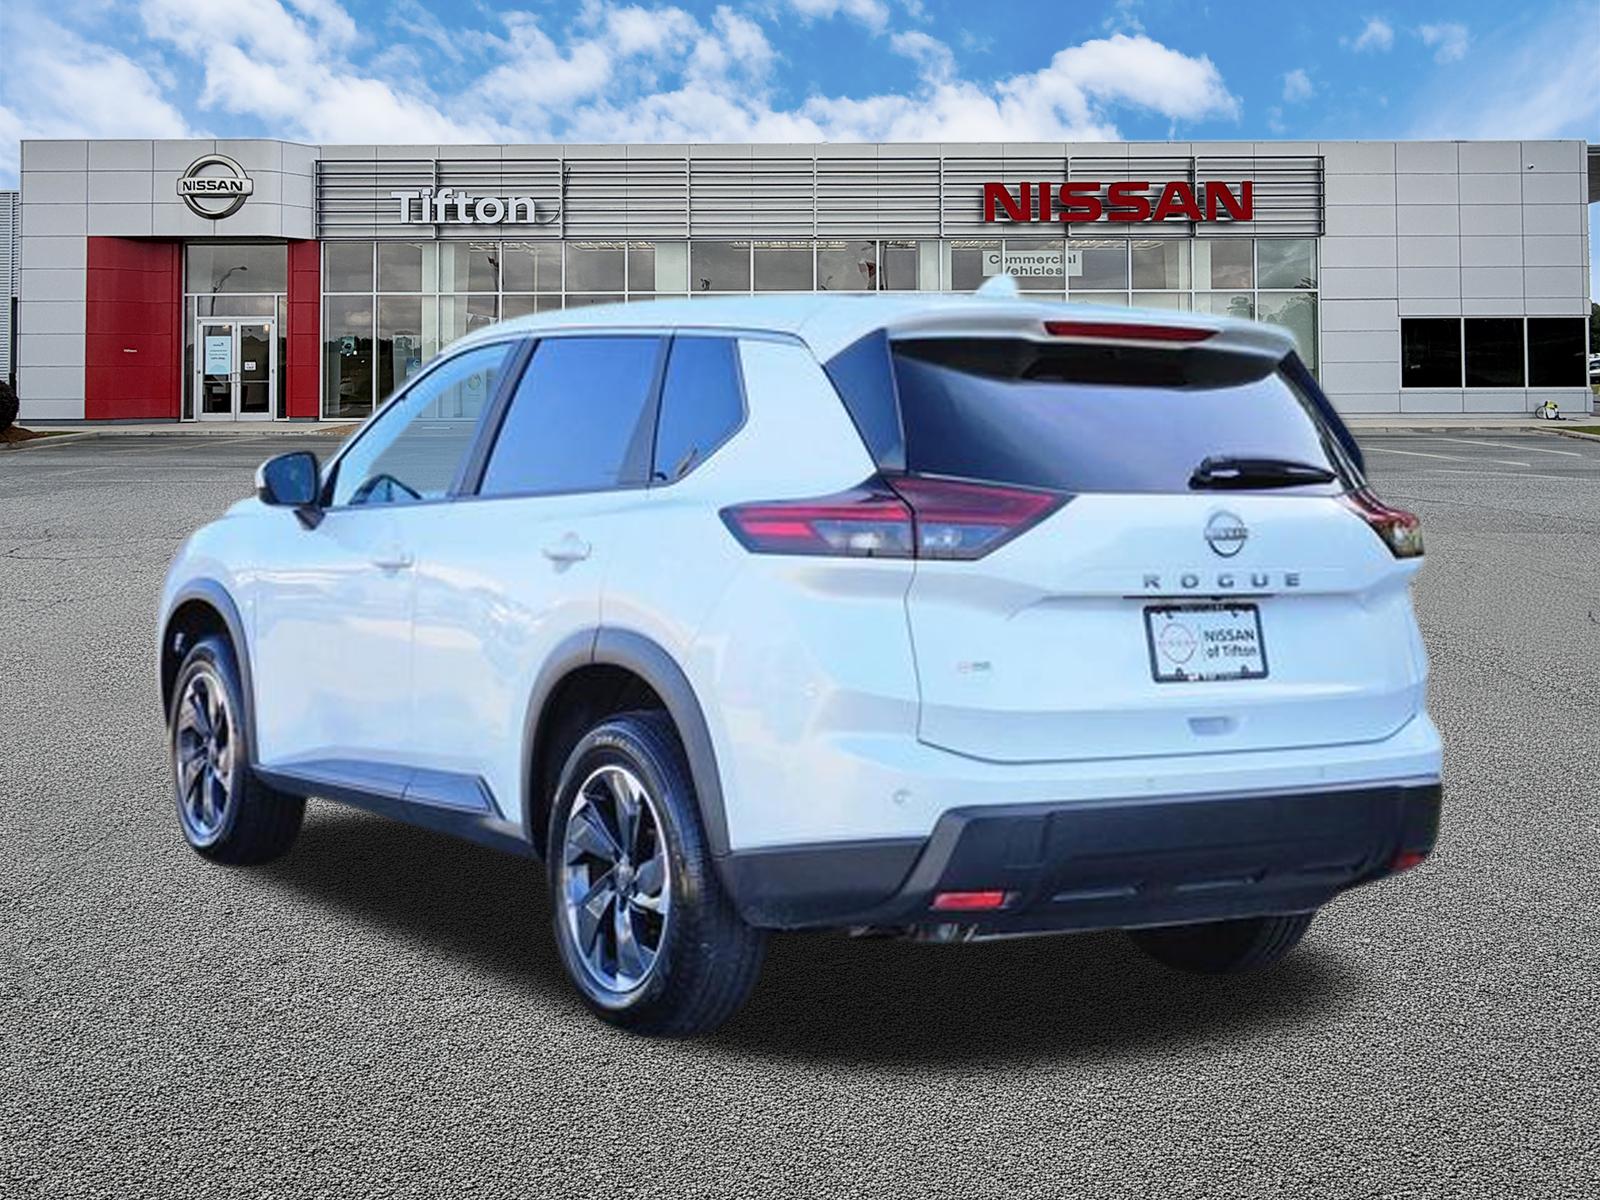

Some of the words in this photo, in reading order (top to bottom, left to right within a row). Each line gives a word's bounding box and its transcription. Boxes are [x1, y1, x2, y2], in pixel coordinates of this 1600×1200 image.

[183, 181, 243, 191] NISSAN
[391, 187, 536, 224] Tifton
[983, 181, 1253, 222] NISSAN
[1143, 573, 1301, 589] ROGUE
[1204, 628, 1255, 642] NISSAN
[1206, 644, 1219, 658] of
